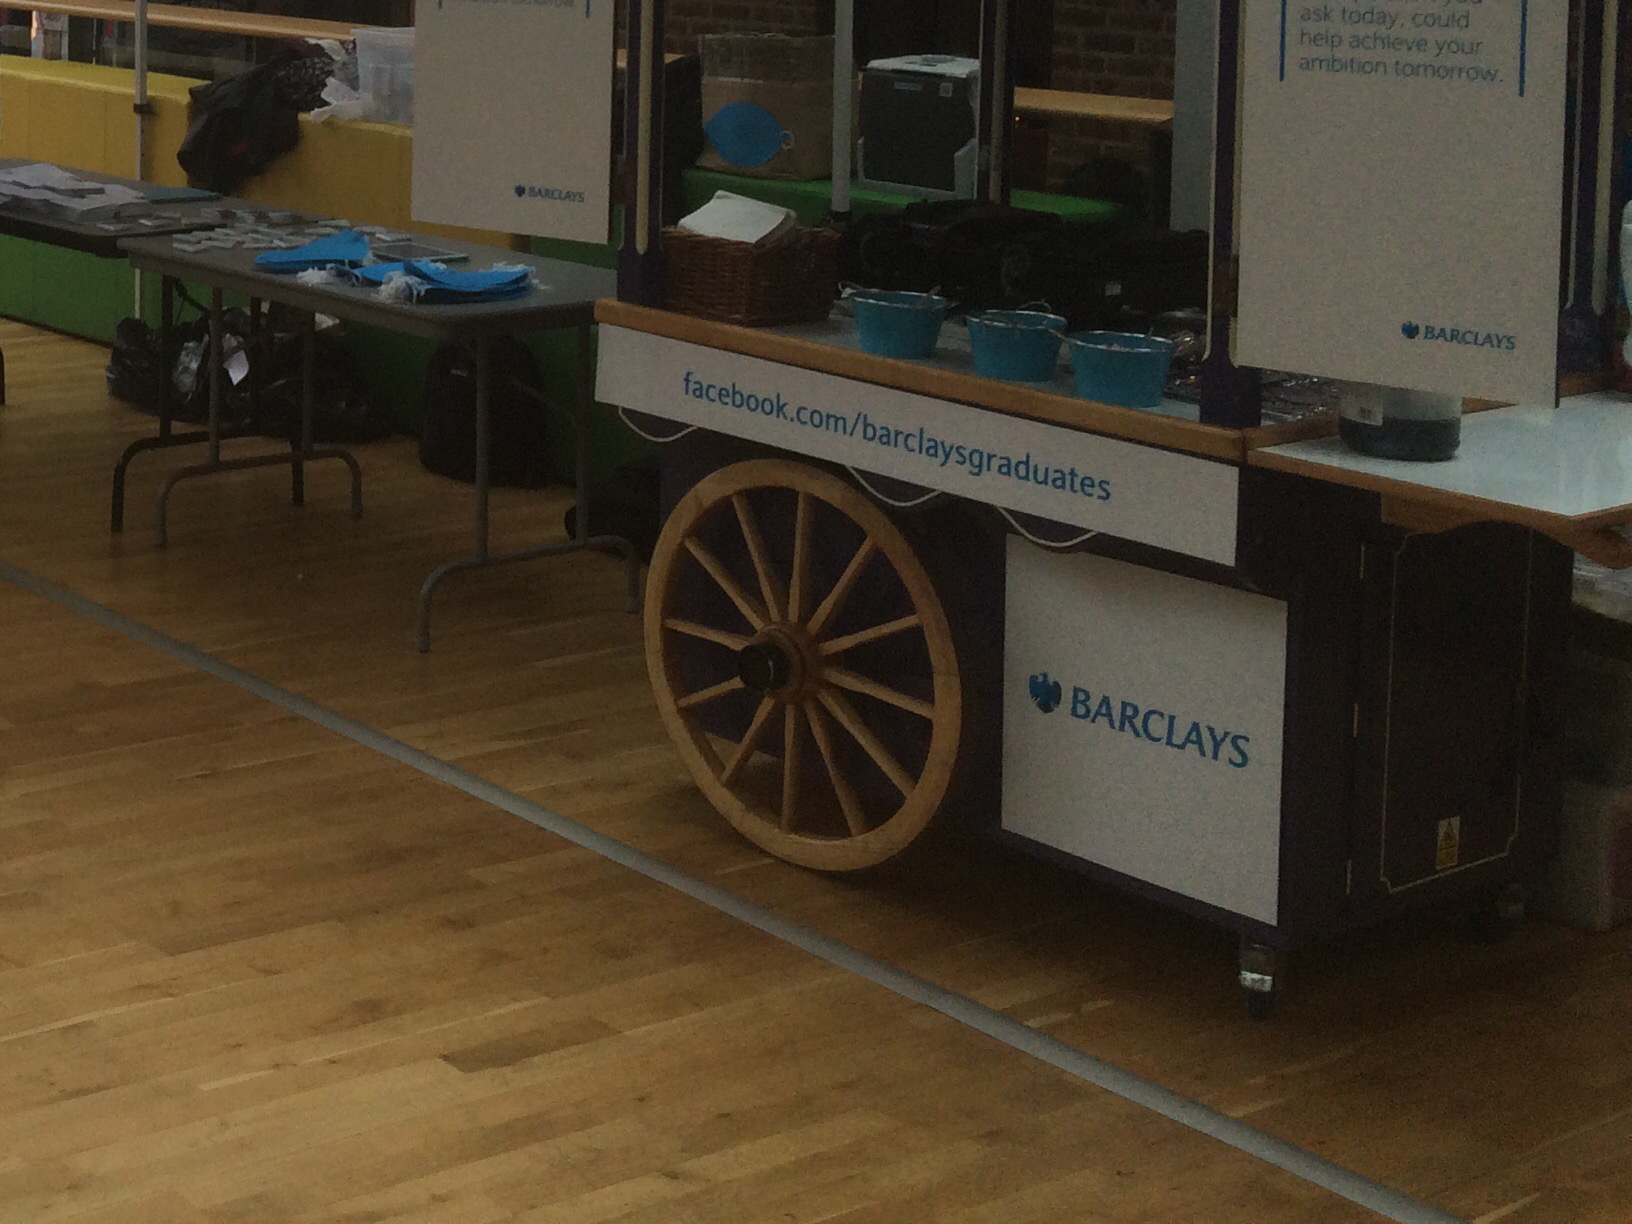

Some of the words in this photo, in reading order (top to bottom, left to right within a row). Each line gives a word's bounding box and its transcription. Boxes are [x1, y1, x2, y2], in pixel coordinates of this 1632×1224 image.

[1299, 5, 1332, 23] ask
[1341, 6, 1404, 30] today,
[1412, 10, 1470, 29] could
[1299, 30, 1342, 50] help
[1348, 32, 1429, 53] achieve
[1434, 38, 1483, 57] your
[1299, 54, 1388, 75] ambition
[1395, 60, 1505, 83] tomorrow.
[528, 186, 585, 203] BARCLAYS
[1423, 325, 1517, 351] BARCLAYS
[683, 370, 1112, 503] facebook.com/barclaysgraduates
[1070, 684, 1251, 769] BARCLAYS
